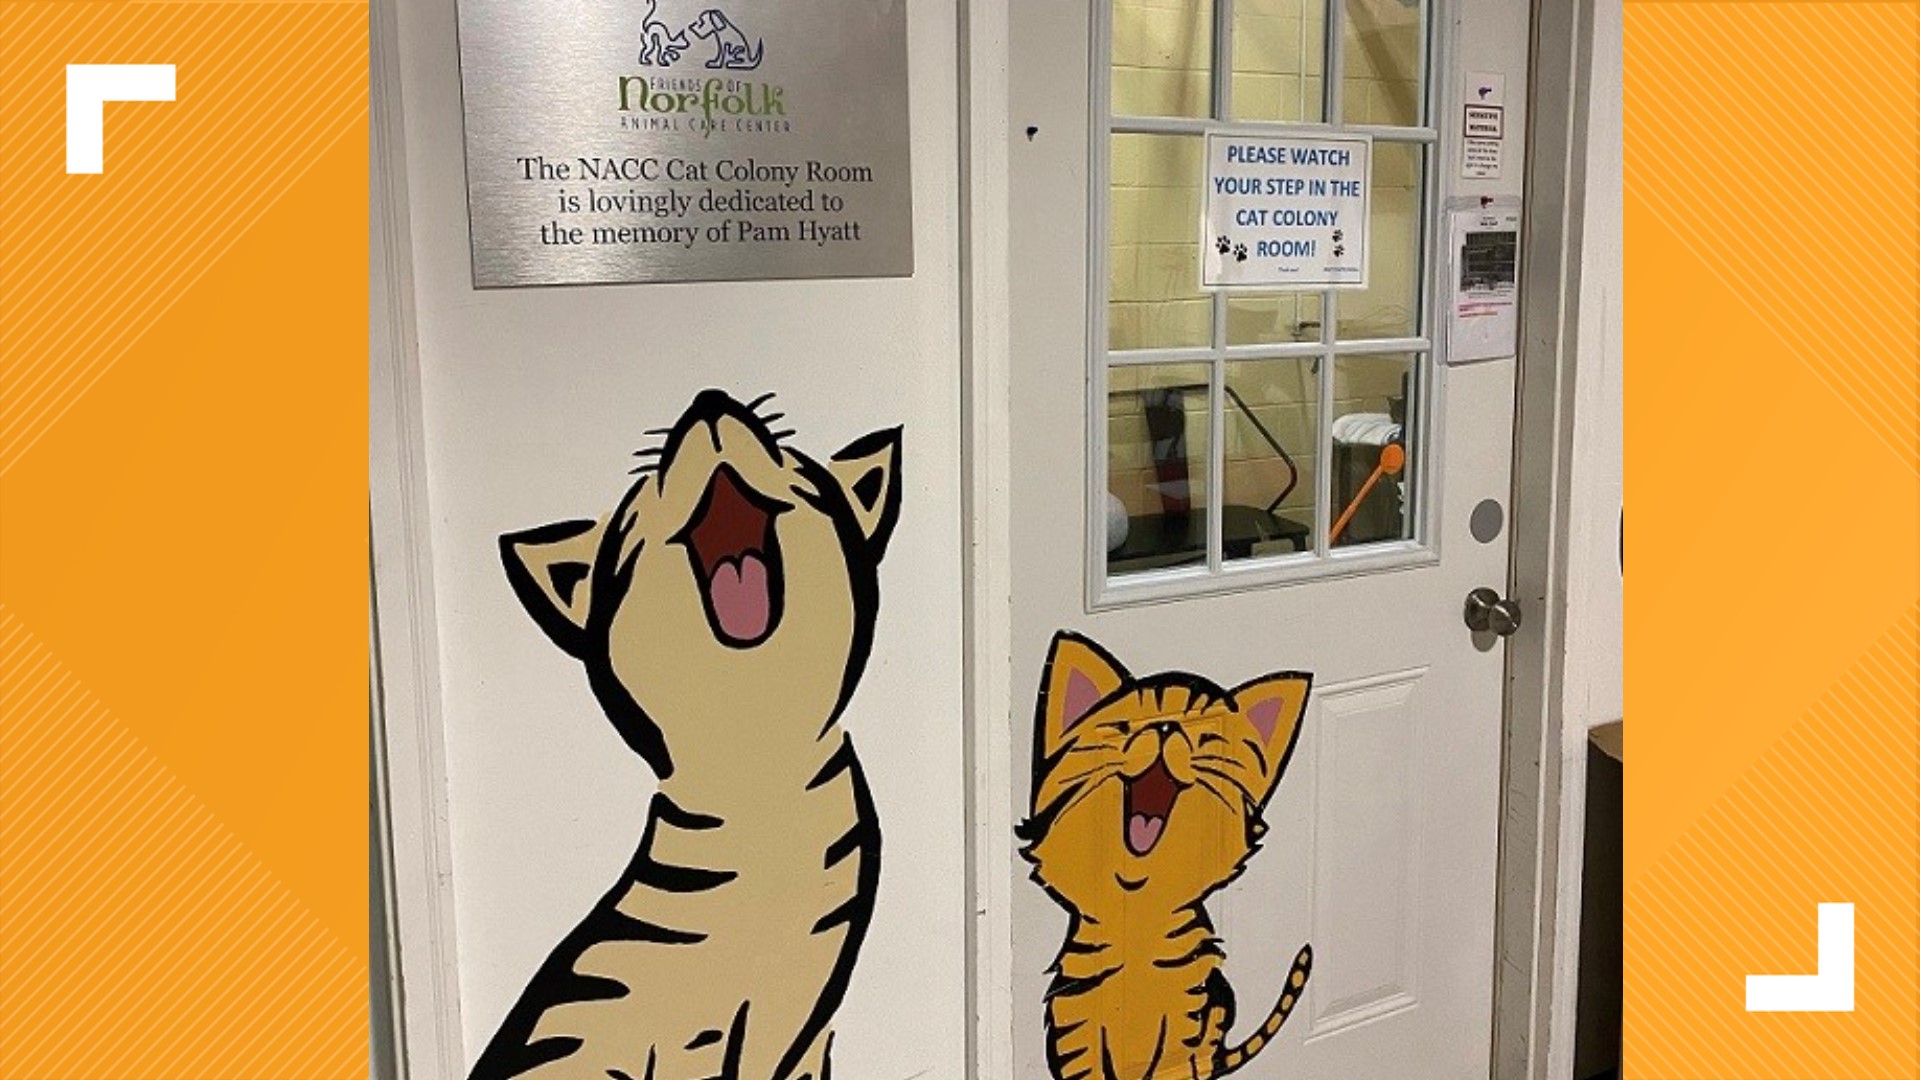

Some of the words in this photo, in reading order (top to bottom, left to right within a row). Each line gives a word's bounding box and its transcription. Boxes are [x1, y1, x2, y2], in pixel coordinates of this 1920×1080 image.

[650, 77, 701, 92] FRIENDS
[727, 81, 741, 93] OF
[621, 117, 678, 132] ANIMAL
[688, 118, 727, 132] CARE
[736, 119, 791, 133] CENTER
[1227, 145, 1286, 164] PLEASE
[1290, 148, 1350, 166] WATCH
[517, 156, 570, 181] The
[577, 157, 660, 181] NACC
[666, 158, 707, 181] Cat
[715, 158, 799, 188] Colony
[805, 160, 873, 183] Room
[1214, 177, 1262, 195] YOUR
[1266, 178, 1304, 195] STEP
[1308, 179, 1326, 196] IN
[1330, 180, 1360, 197] THE
[558, 188, 581, 213] is
[588, 188, 692, 218] lovingly
[699, 188, 815, 213] dedicated
[821, 193, 845, 212] to
[1235, 209, 1268, 226] CAT
[1272, 209, 1339, 227] COLONY
[540, 221, 584, 245] the
[592, 225, 699, 249] memory
[706, 219, 731, 243] of
[738, 220, 790, 242] Pam
[799, 219, 861, 247] Hyatt
[1256, 240, 1316, 258] ROOM!
